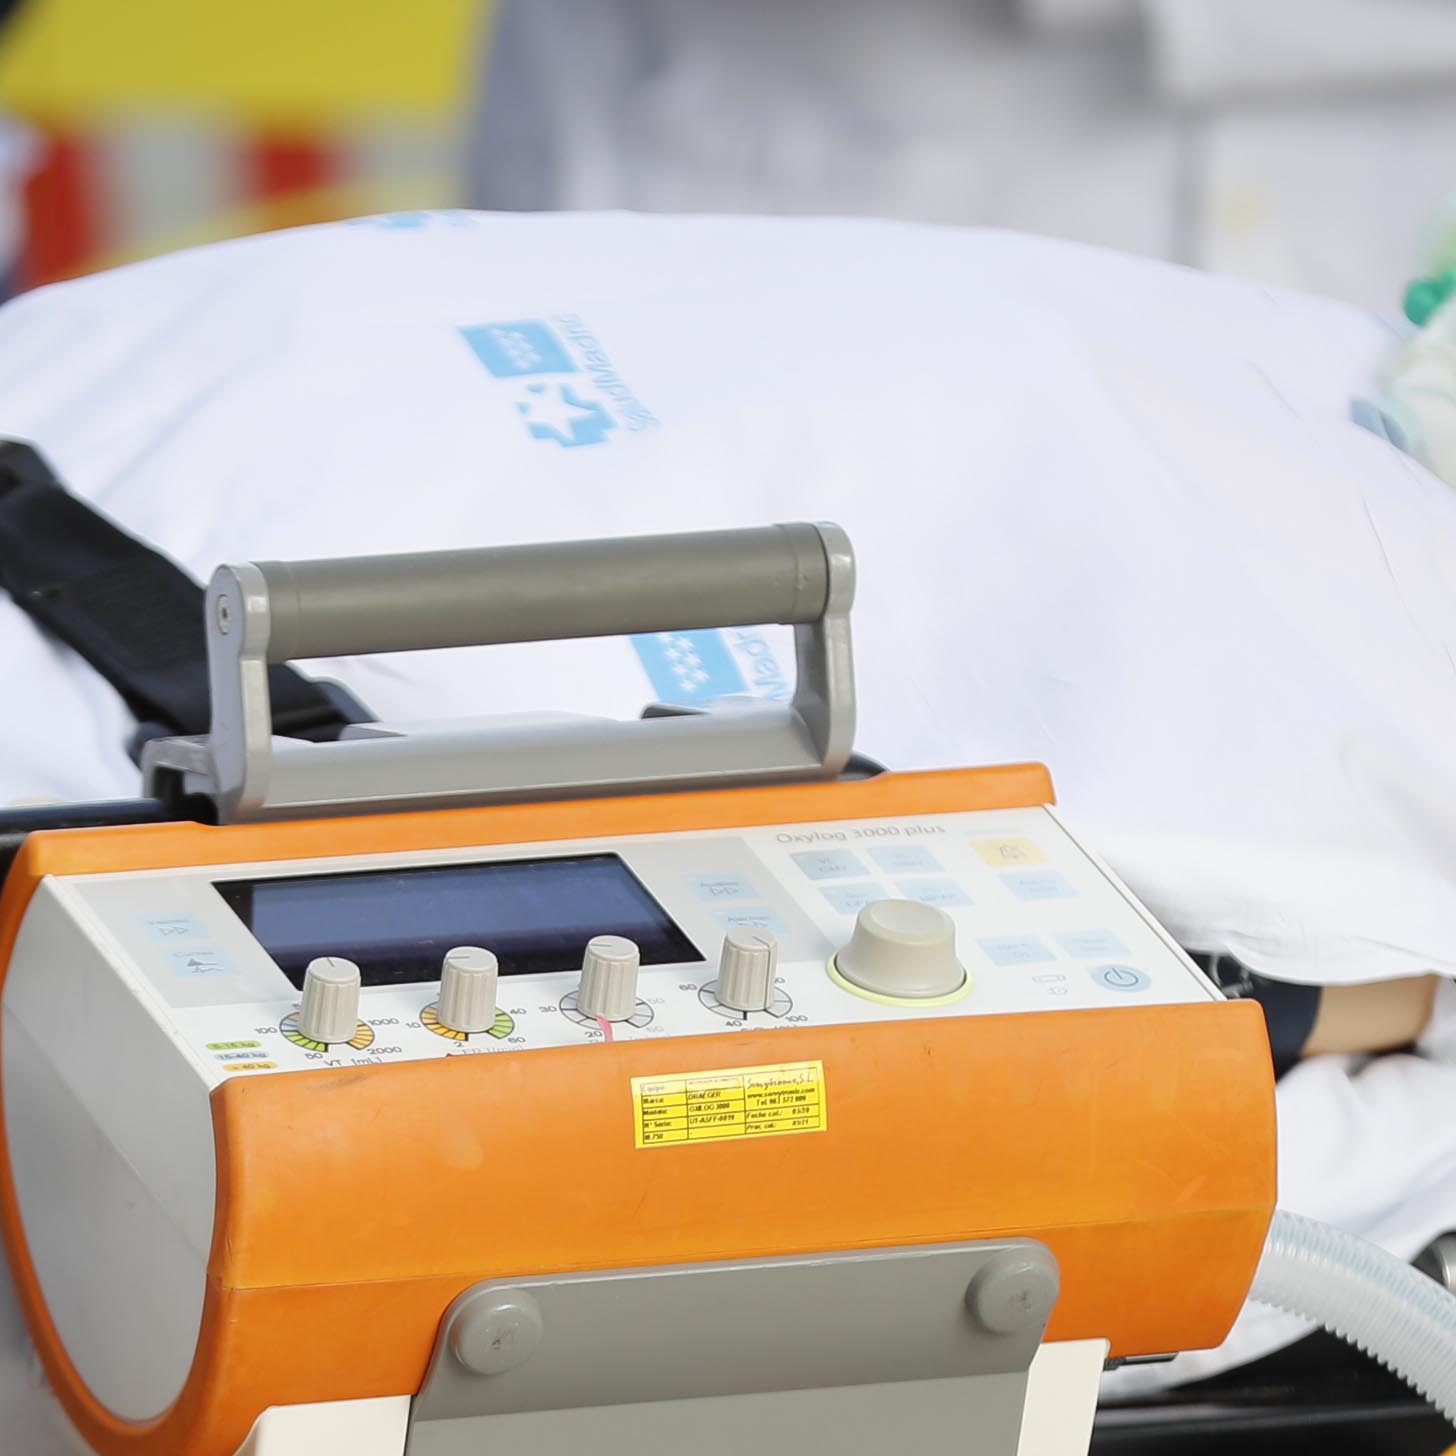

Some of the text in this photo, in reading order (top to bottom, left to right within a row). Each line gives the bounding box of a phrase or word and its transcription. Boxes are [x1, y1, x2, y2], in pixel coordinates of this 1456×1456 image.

[775, 823, 946, 846] Oxylog 3000 plus
[367, 1017, 399, 1026] 1000
[254, 1026, 278, 1035] 100
[585, 1030, 603, 1038] 20
[366, 1046, 402, 1055] 2000
[305, 1052, 323, 1060] 50
